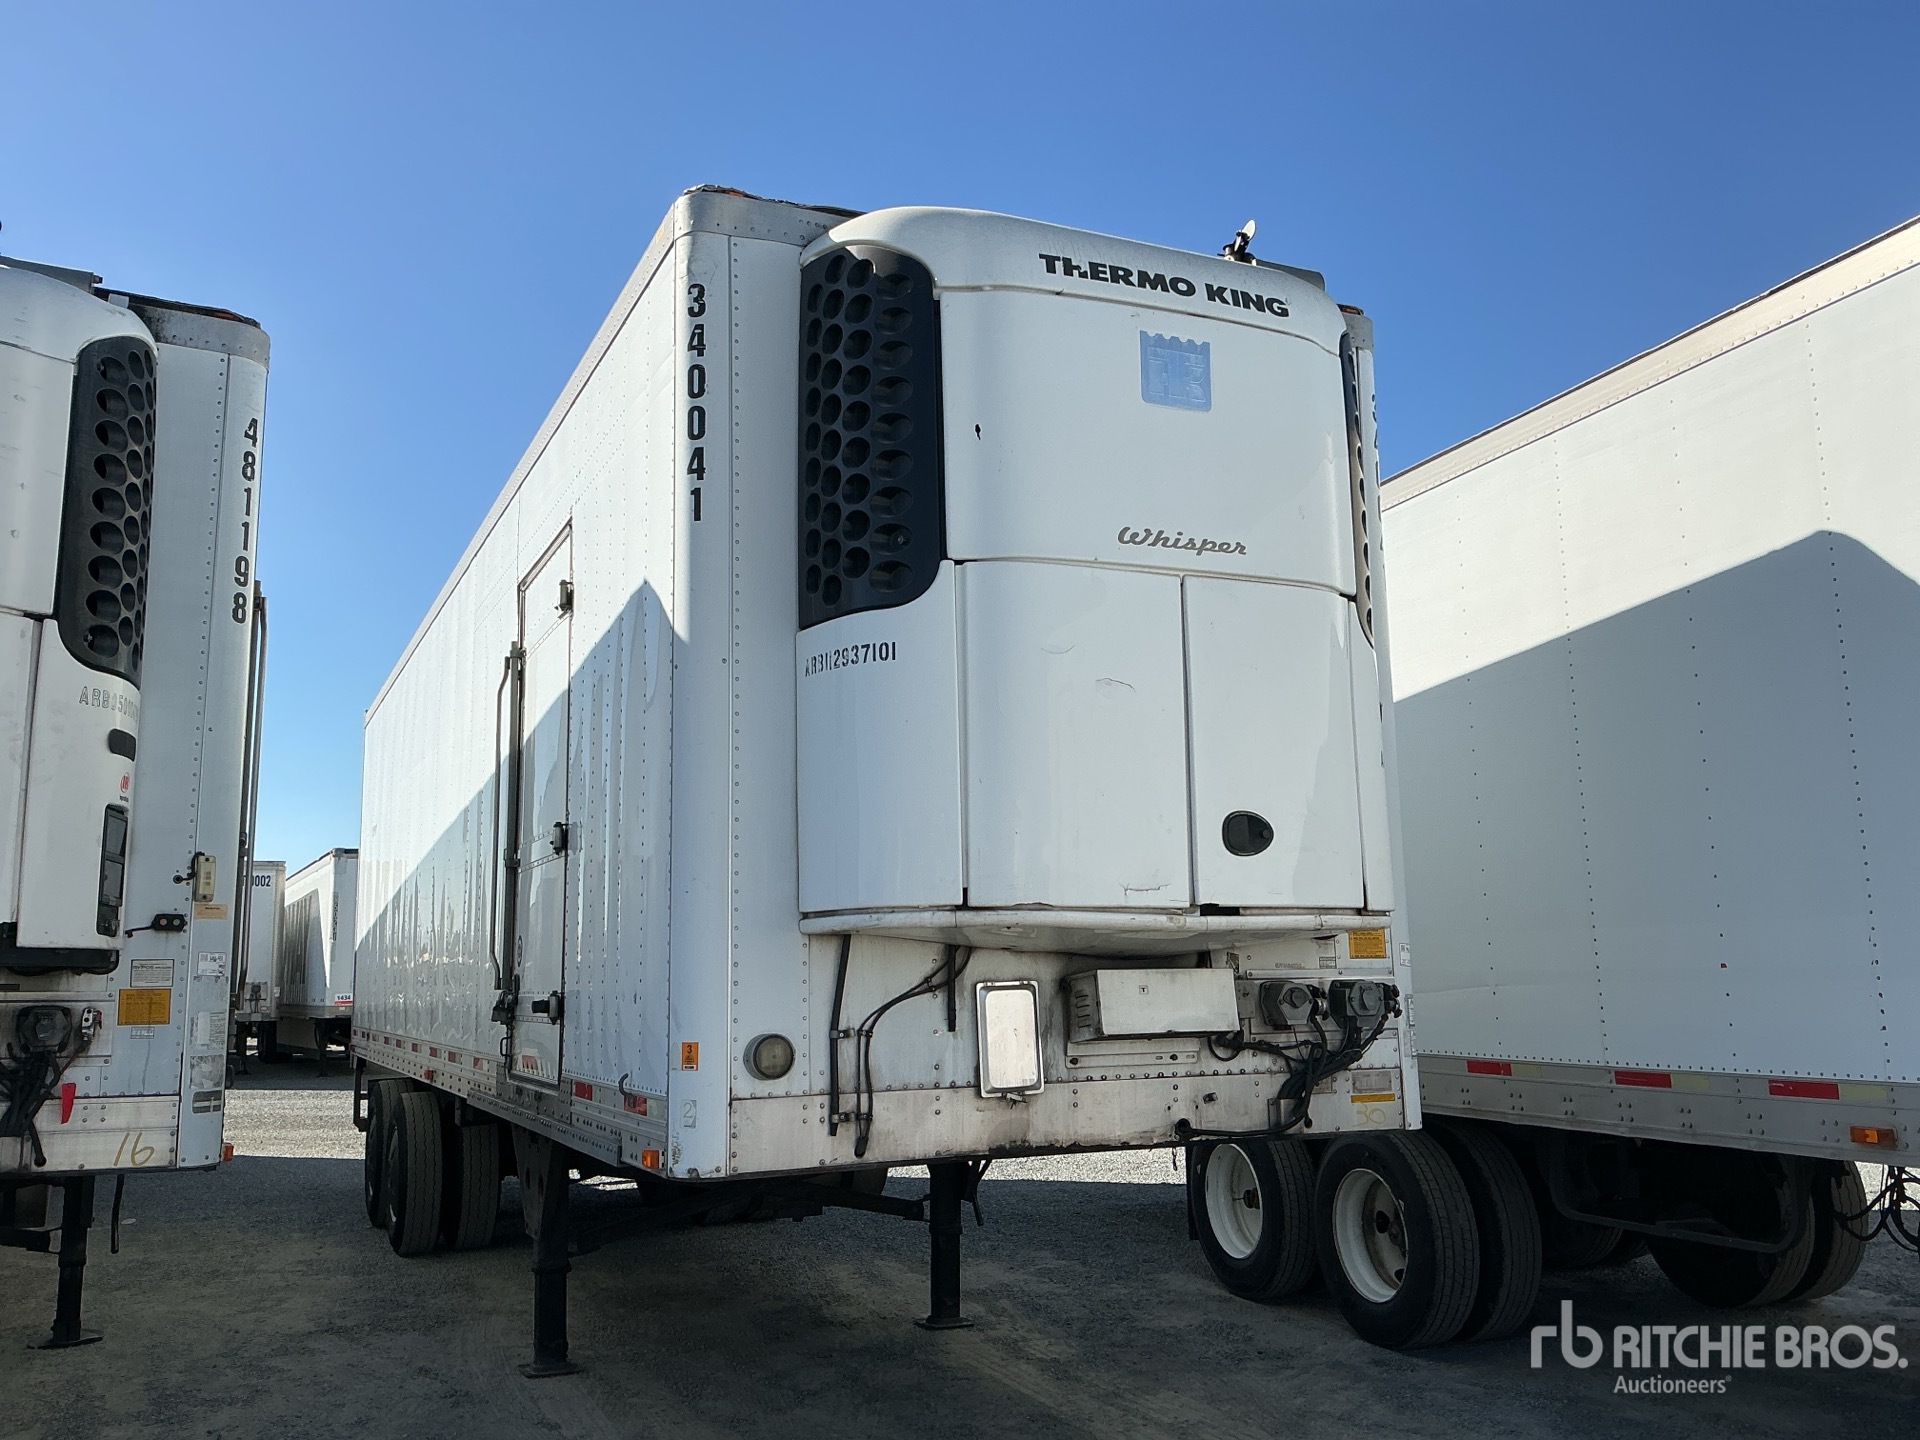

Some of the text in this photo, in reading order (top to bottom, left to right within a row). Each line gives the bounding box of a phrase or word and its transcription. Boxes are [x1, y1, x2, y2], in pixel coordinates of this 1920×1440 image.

[1039, 253, 1290, 318] THERMO KING
[686, 283, 707, 522] 340041
[231, 418, 258, 624] 481198
[1117, 526, 1247, 556] Whisper
[113, 1131, 155, 1168] 16
